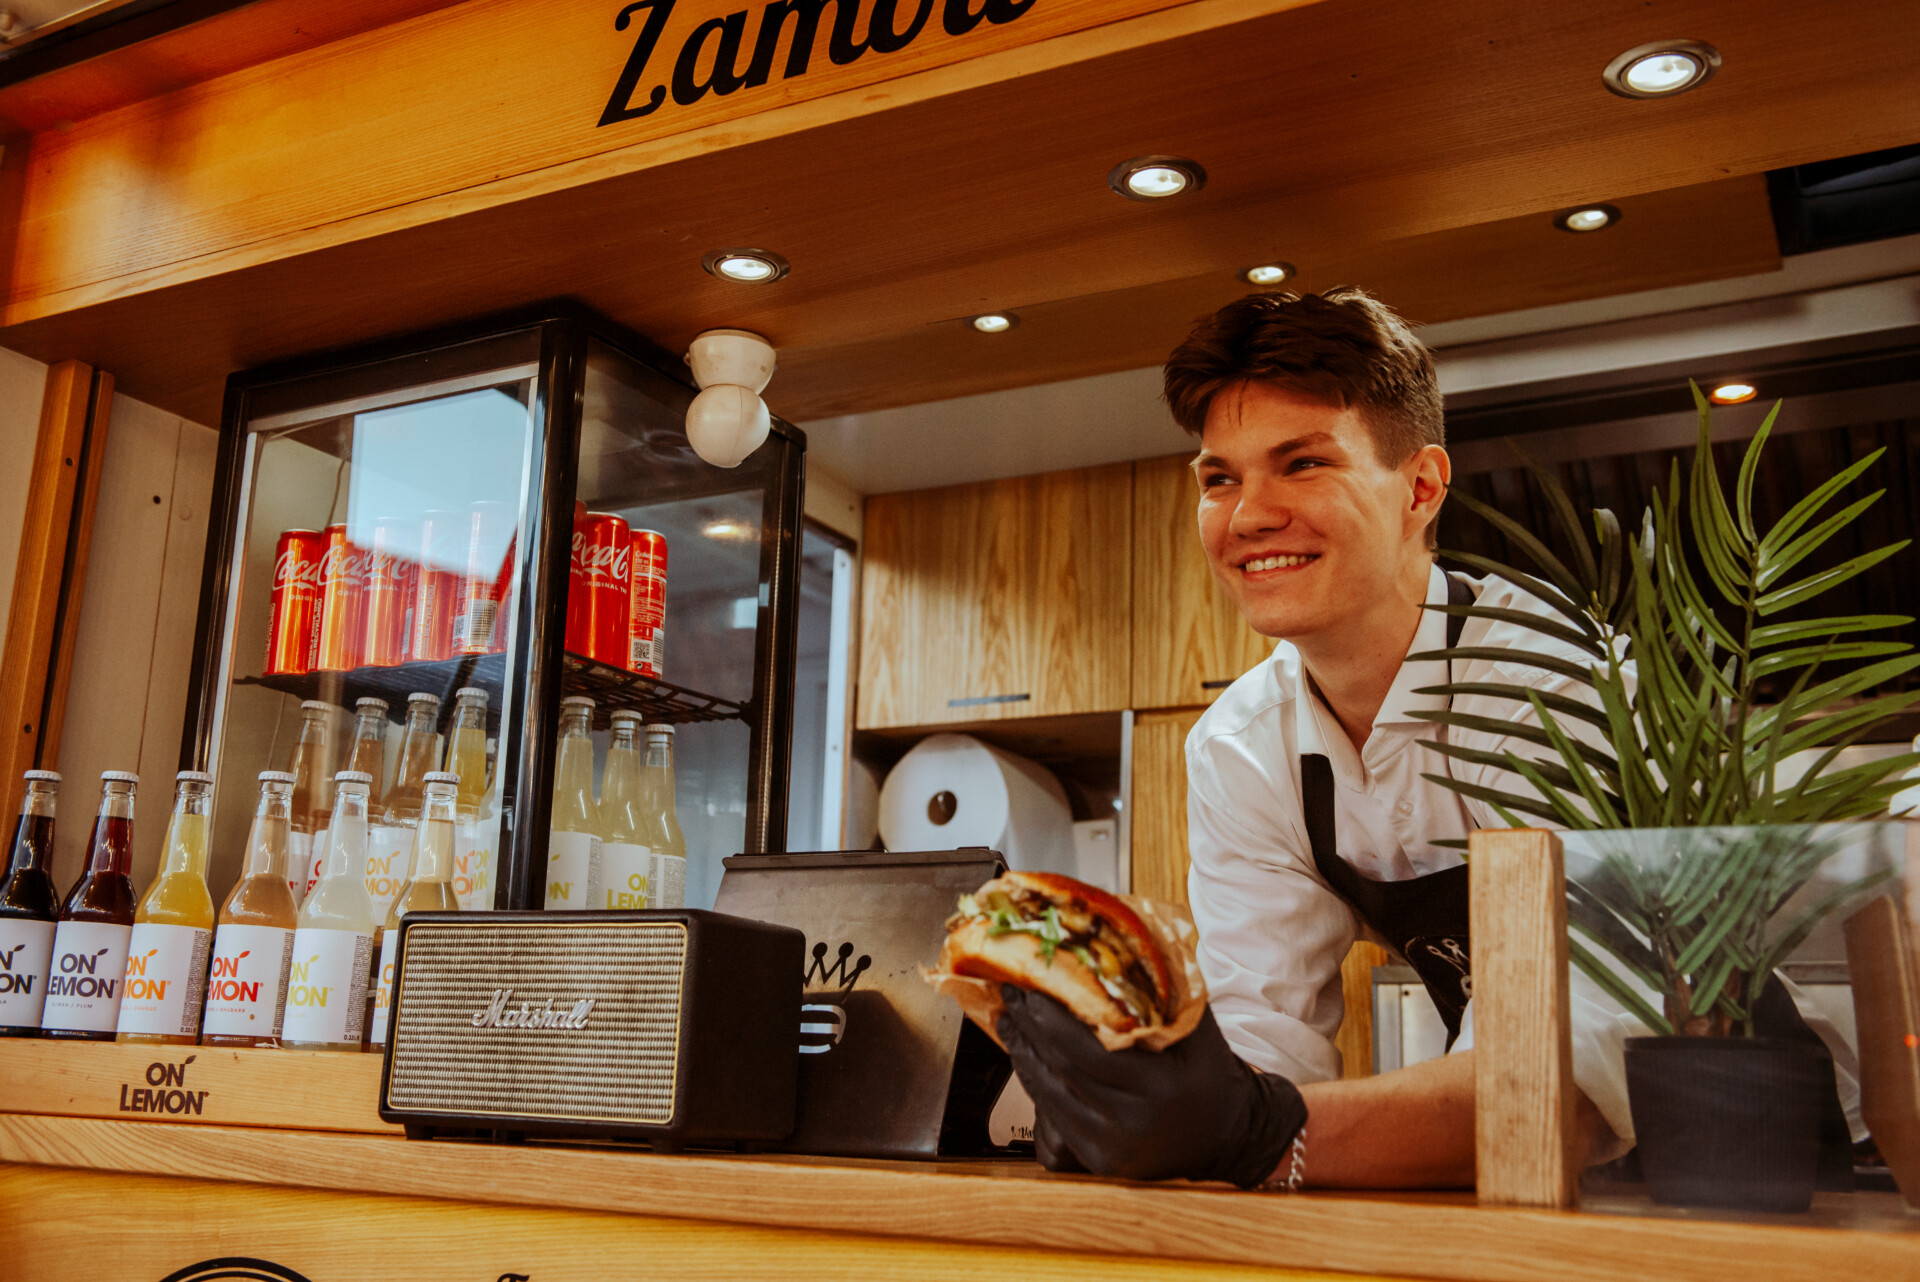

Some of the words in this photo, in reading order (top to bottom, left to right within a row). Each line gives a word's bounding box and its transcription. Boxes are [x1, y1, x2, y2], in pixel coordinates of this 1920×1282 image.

[367, 857, 391, 875] ON
[454, 855, 469, 874] N
[61, 953, 97, 975] ON
[213, 957, 239, 977] ON
[0, 973, 33, 994] ON
[47, 976, 115, 998] EMON
[472, 989, 596, 1029] Marshall
[146, 1062, 186, 1088] ON
[119, 1084, 205, 1115] LEMON
